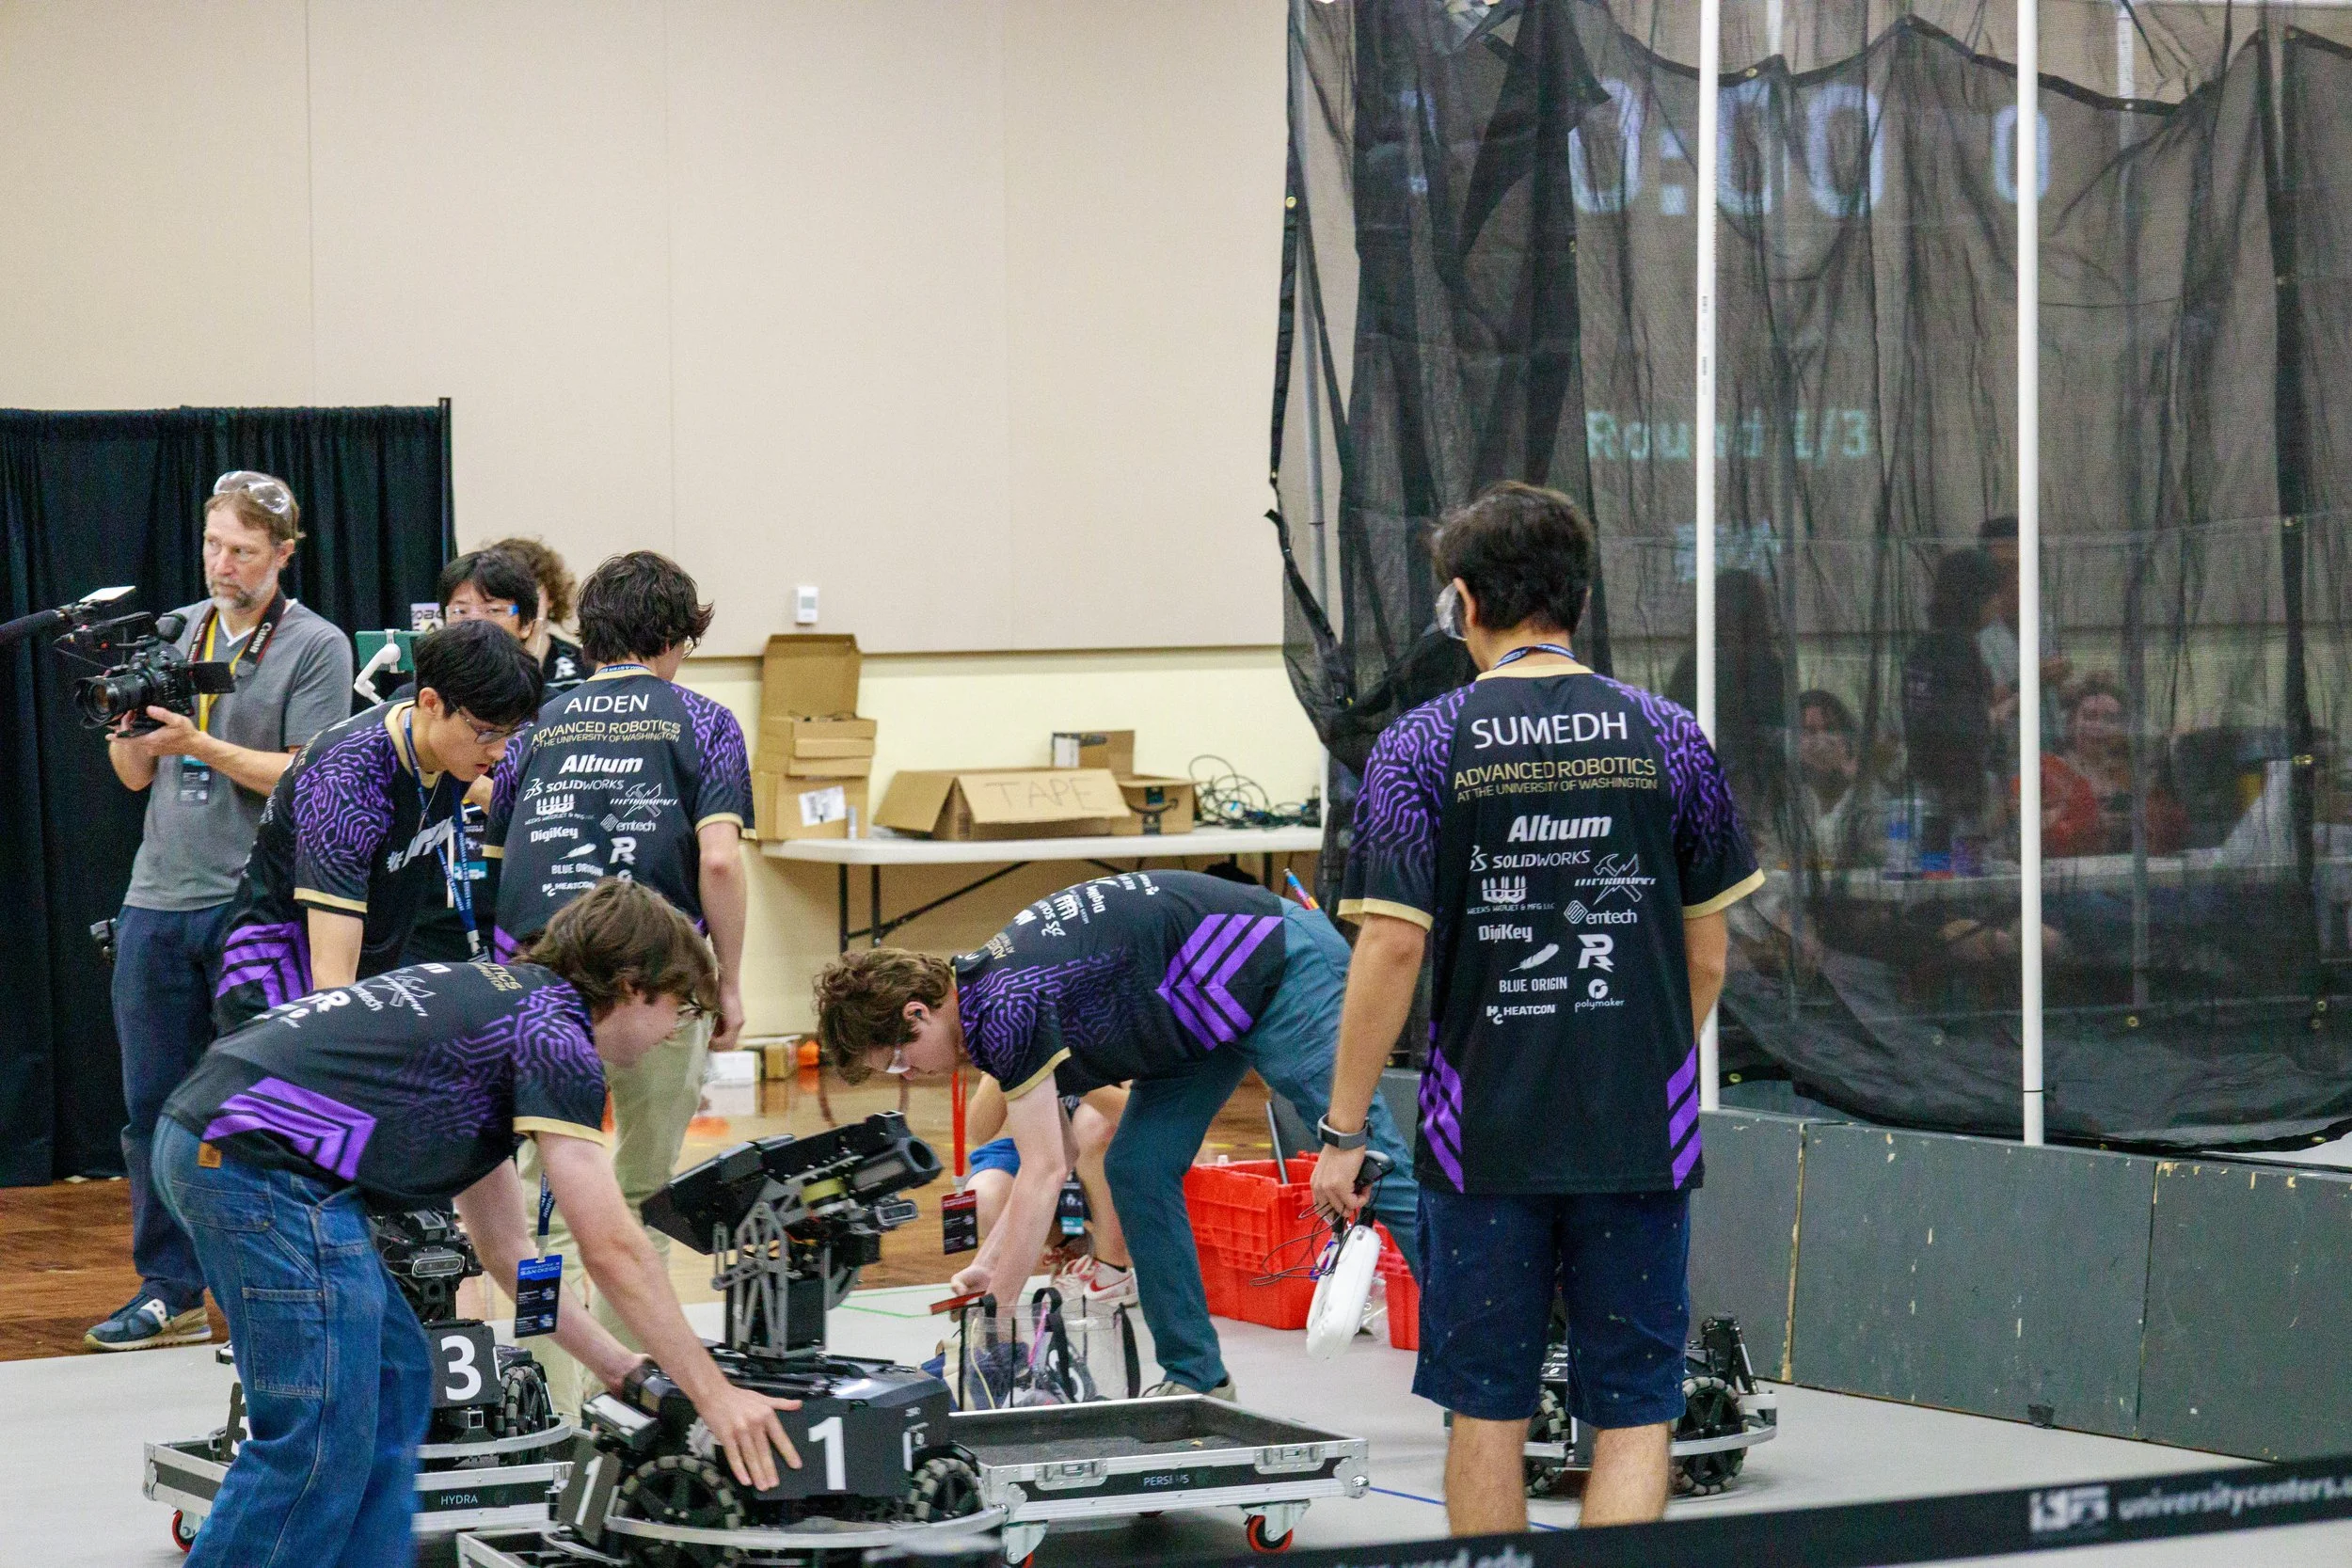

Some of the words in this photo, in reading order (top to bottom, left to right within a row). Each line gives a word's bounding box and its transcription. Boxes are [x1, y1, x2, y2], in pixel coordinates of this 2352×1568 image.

[564, 693, 650, 715] AIDEN
[531, 721, 607, 746] ADVANCED
[608, 719, 682, 735] ROBOTICS
[556, 734, 608, 745] UNIVERSITY
[610, 734, 622, 743] OF
[622, 731, 680, 743] WASHINGTON
[1470, 710, 1629, 750] SUMEDH
[559, 753, 644, 775] Altium
[1454, 761, 1556, 790] ADVANCED
[1558, 756, 1657, 779] ROBOTICS
[546, 779, 626, 794] SOLIDWORKS
[984, 776, 1108, 811] TAPE
[1456, 788, 1474, 803] AT
[1474, 784, 1494, 799] THE
[1495, 780, 1559, 796] UNIVERSITY
[1561, 780, 1577, 792] OF
[1579, 777, 1659, 791] WASHINGTON
[530, 826, 579, 843] DigiKey
[1507, 814, 1613, 843] Altium
[551, 863, 574, 875] BLUE
[1491, 849, 1592, 870] SOLIDWORKS
[1585, 909, 1638, 925] emtech
[1478, 924, 1533, 943] DigiKey
[1499, 978, 1529, 993] BLUE
[1531, 976, 1568, 991] ORIGIN
[1503, 1004, 1556, 1017] HEATCON
[1574, 998, 1626, 1013] polymaker
[439, 1335, 483, 1402] 3
[807, 1416, 847, 1491] 1
[574, 1454, 604, 1527] 1
[1142, 1473, 1190, 1488] PERSS
[440, 1494, 479, 1505] HYDRA
